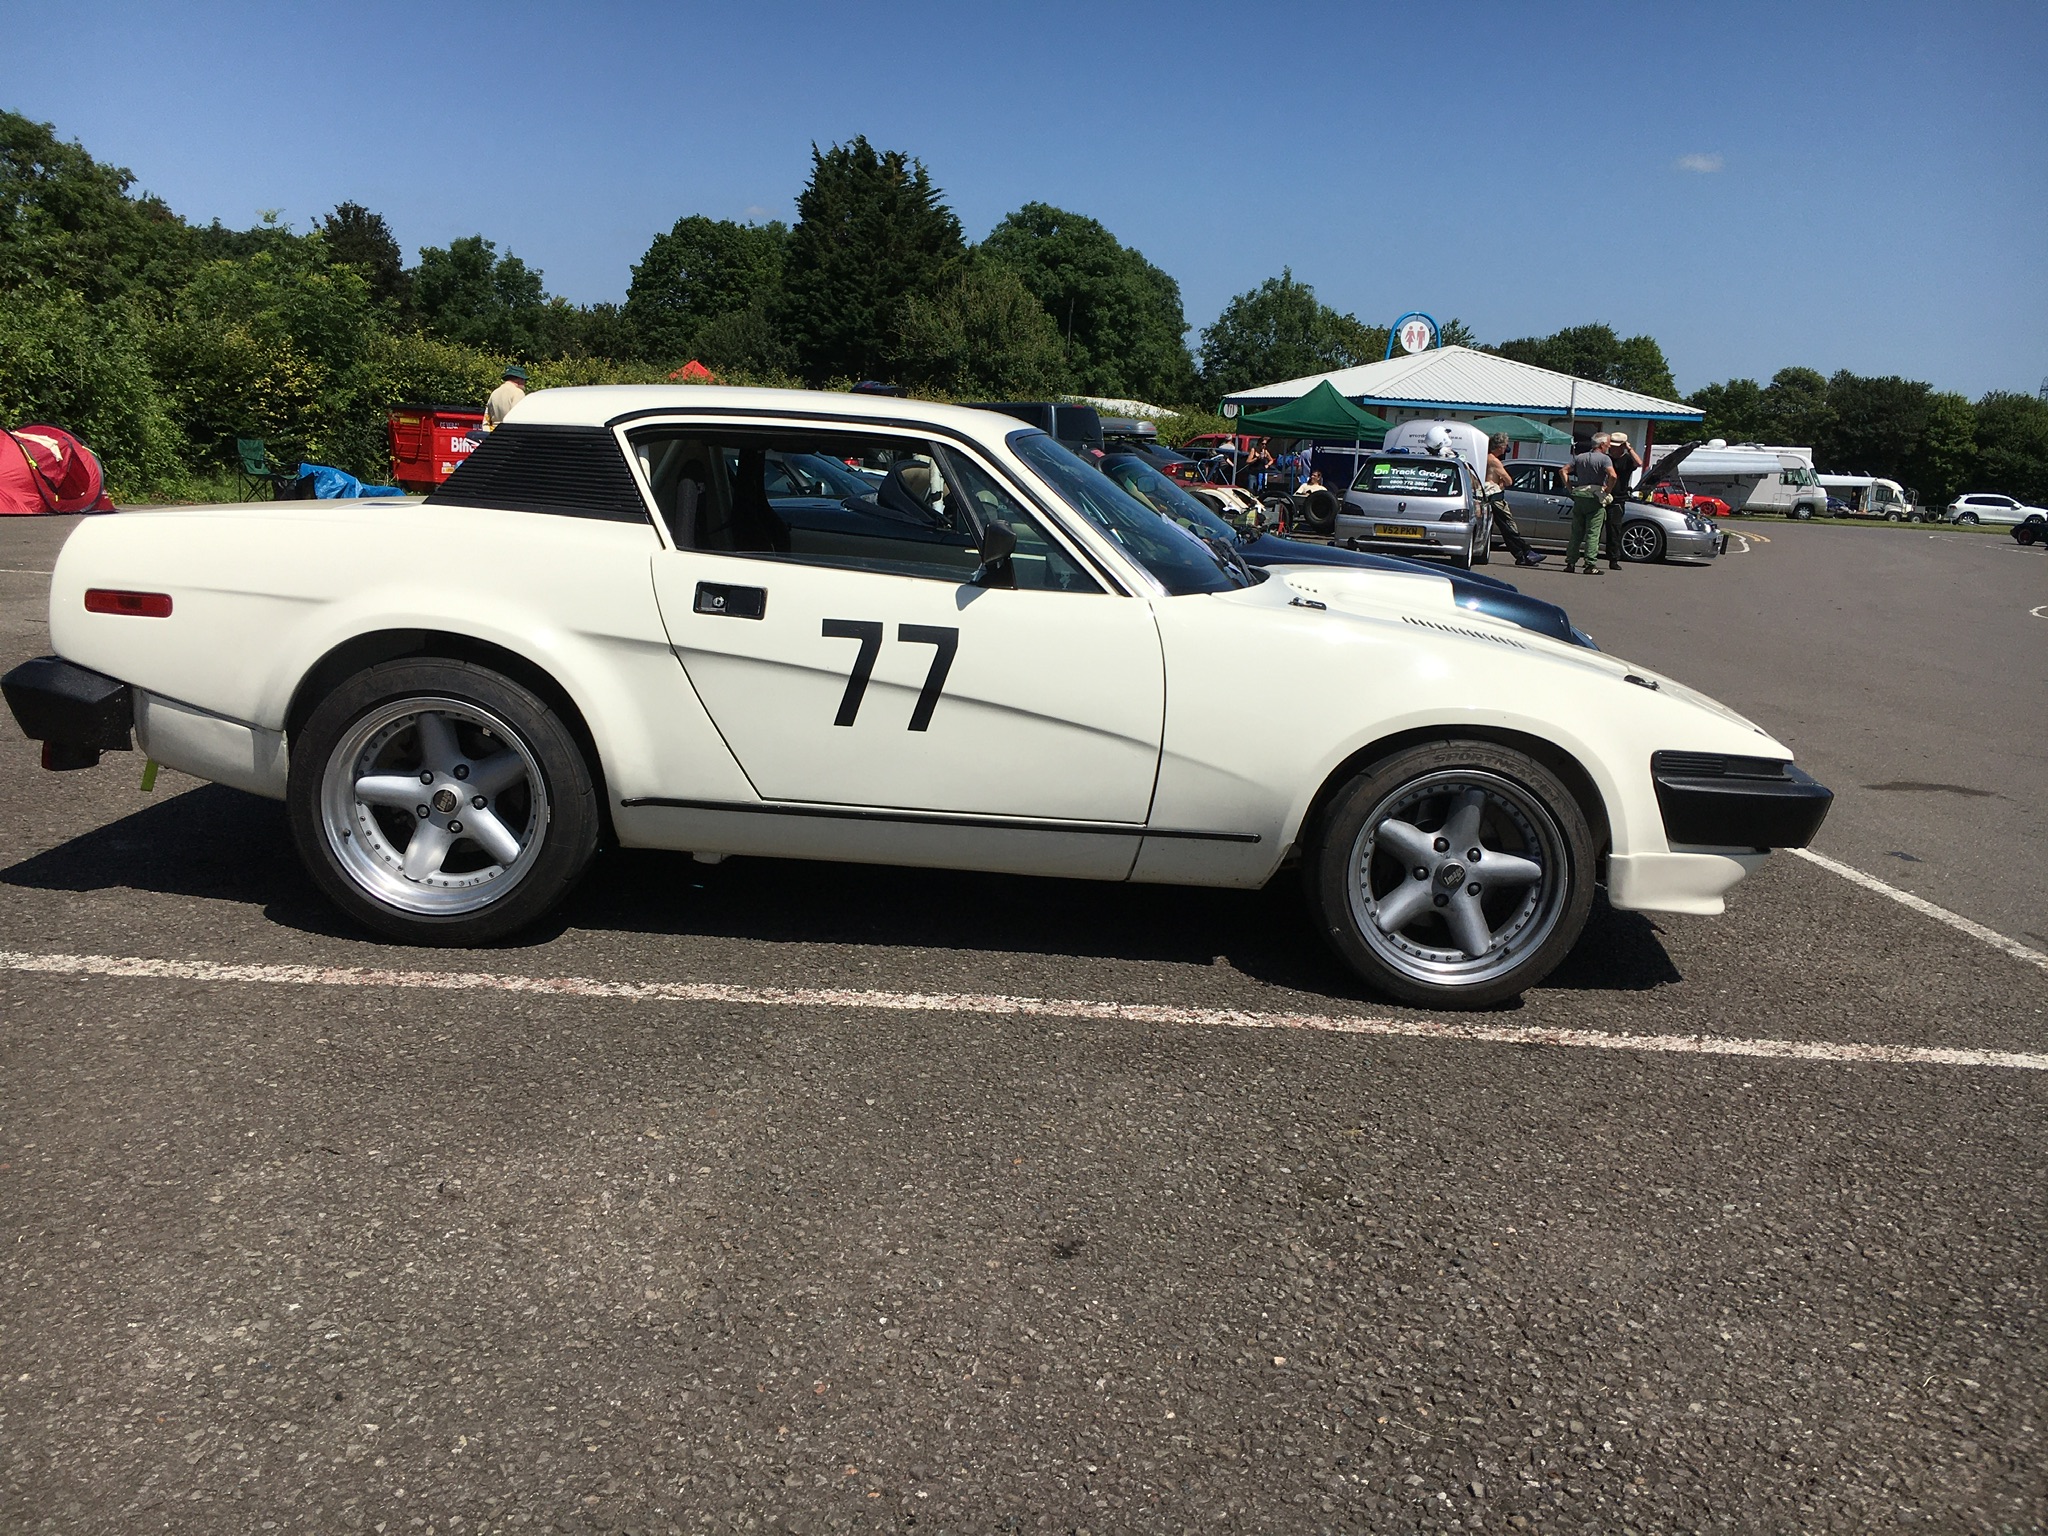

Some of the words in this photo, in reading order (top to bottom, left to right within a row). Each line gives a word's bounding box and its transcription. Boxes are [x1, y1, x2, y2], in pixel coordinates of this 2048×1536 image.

[1391, 468, 1416, 476] Track
[1418, 469, 1448, 480] Group
[1557, 504, 1573, 515] 77
[822, 618, 959, 732] 77
